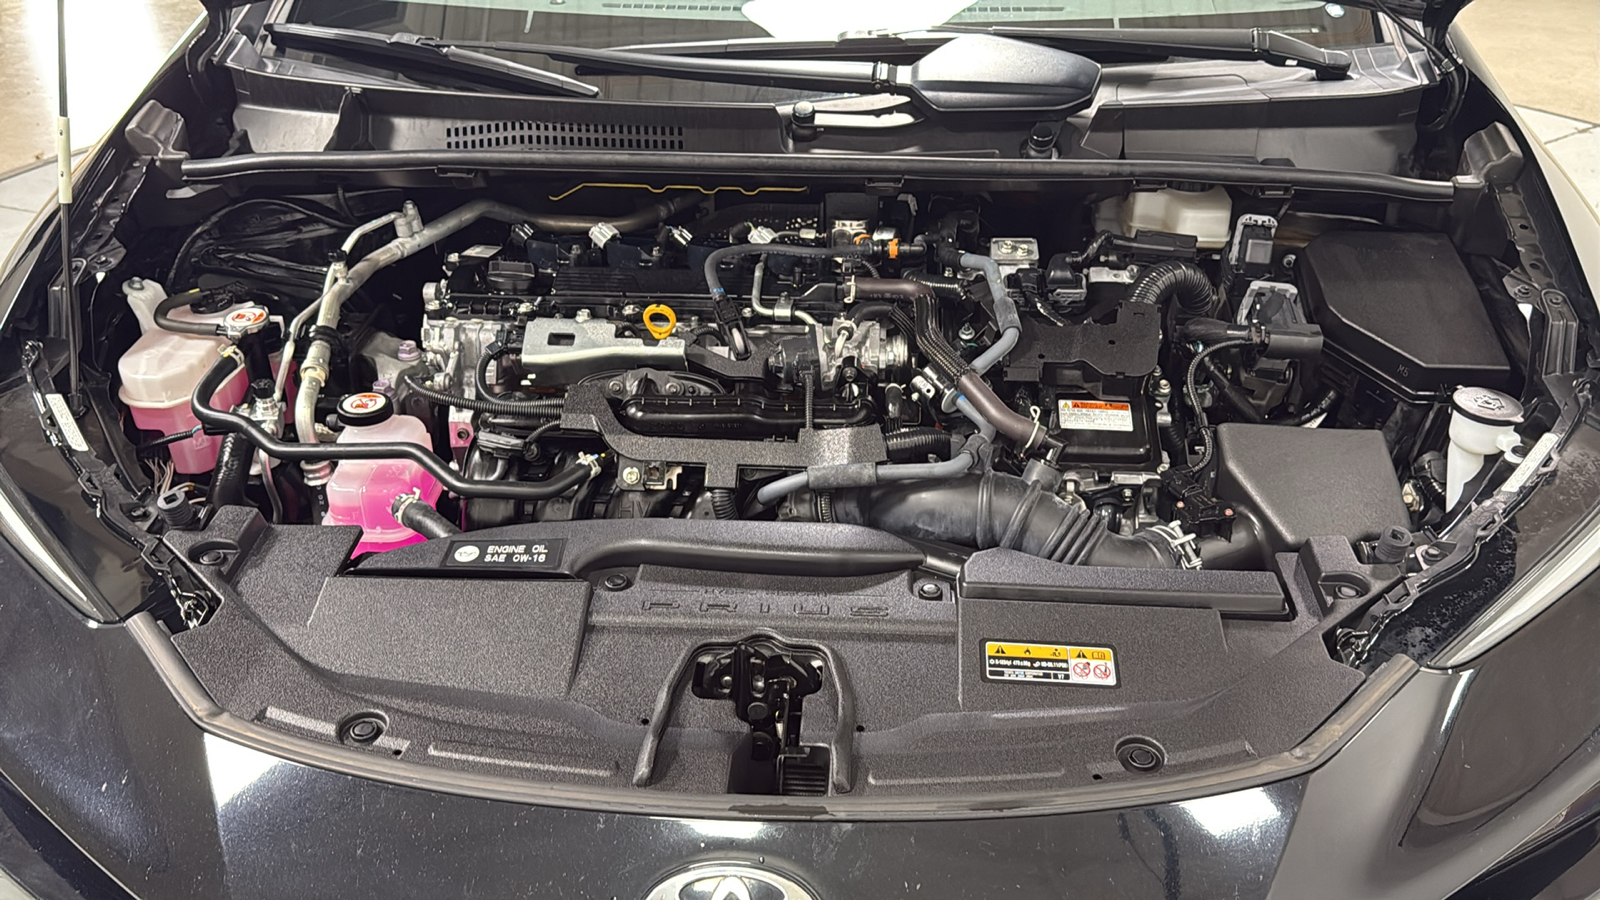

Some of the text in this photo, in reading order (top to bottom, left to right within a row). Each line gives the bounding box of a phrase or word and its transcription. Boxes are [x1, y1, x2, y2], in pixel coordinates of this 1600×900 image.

[487, 544, 548, 554] ENGINE OIL
[484, 554, 546, 562] SAE 0W-16
[642, 600, 889, 617] PRIUS
